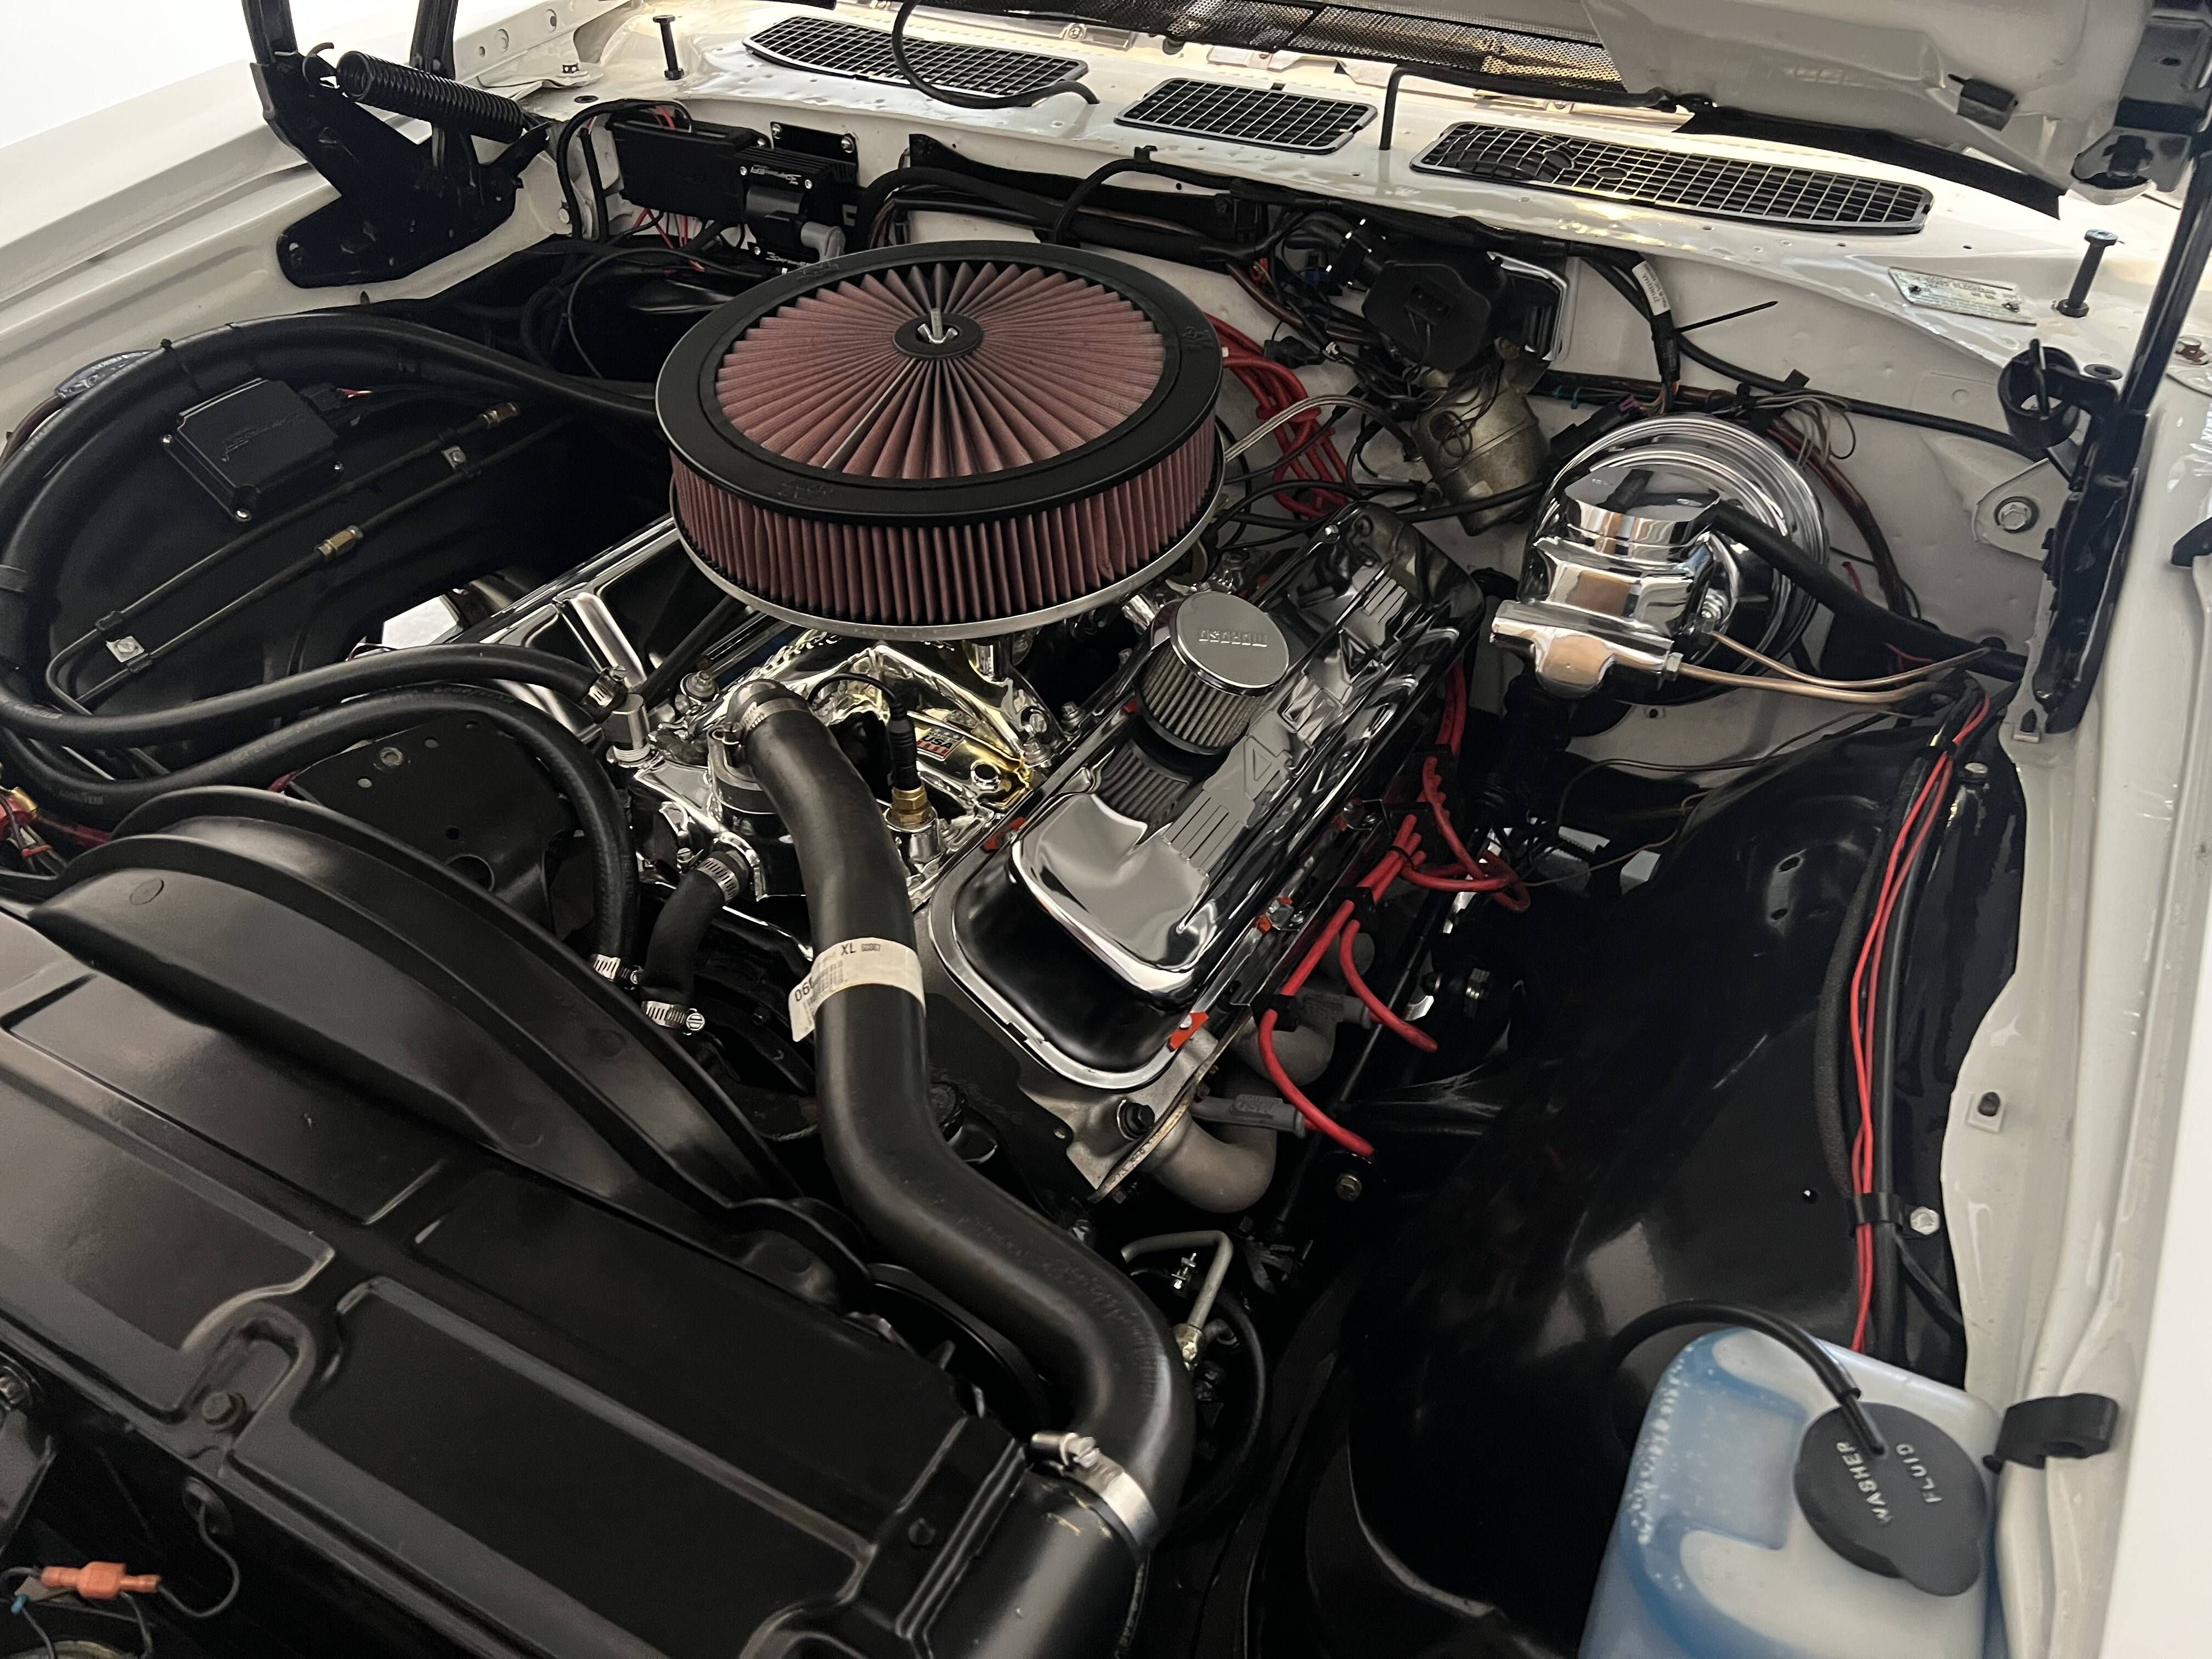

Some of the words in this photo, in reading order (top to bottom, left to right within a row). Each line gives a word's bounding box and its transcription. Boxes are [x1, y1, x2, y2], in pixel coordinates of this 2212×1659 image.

[922, 735, 953, 749] USA
[841, 943, 856, 956] XL
[1837, 1442, 1893, 1523] WASHER
[1896, 1444, 1943, 1502] FLUID
